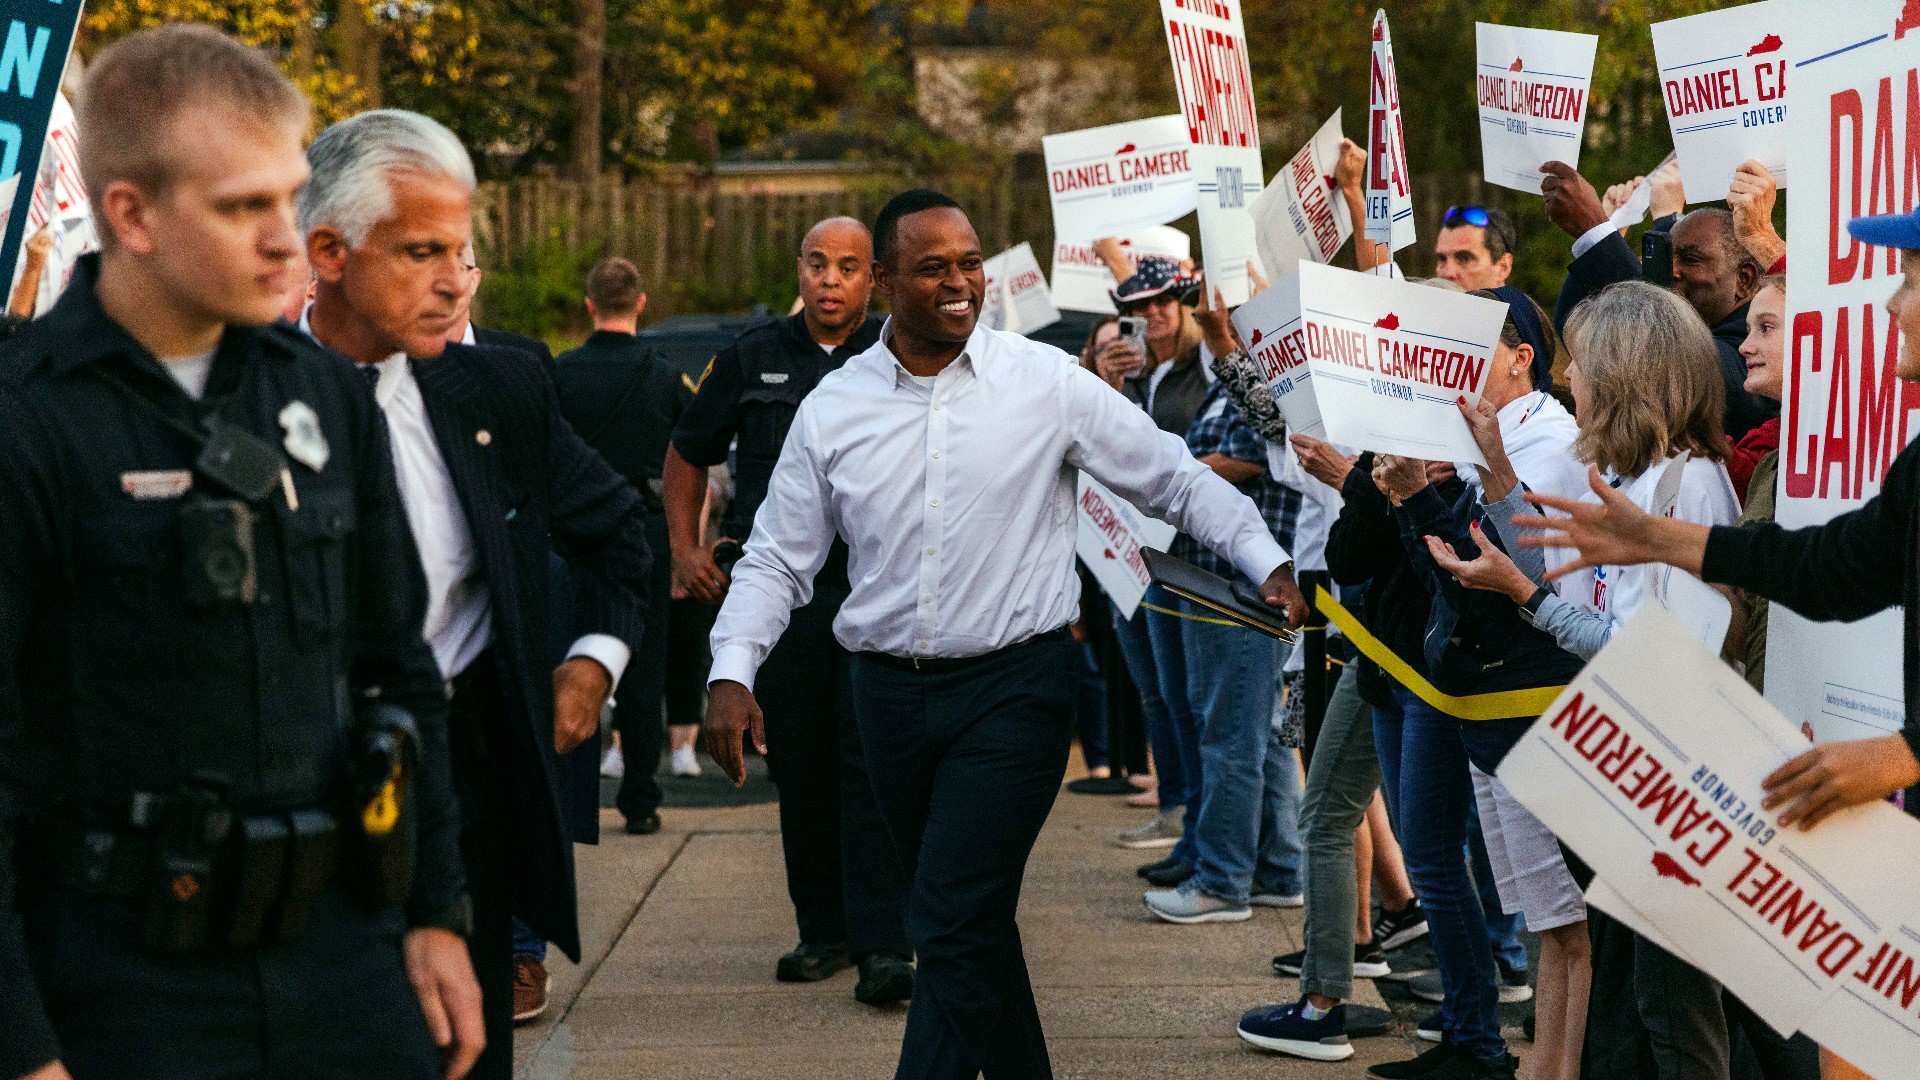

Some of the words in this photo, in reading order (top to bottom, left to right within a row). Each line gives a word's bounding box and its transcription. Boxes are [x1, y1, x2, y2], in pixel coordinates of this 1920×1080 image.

[1479, 75, 1509, 111] DANIEL
[1511, 80, 1583, 122] CAMERON
[1666, 68, 1749, 117] DANIEL
[1742, 105, 1787, 128] GOVER
[1053, 162, 1116, 193] DANIEL
[1302, 185, 1342, 264] CAMERON
[1306, 320, 1375, 372] DANIEL
[1377, 337, 1486, 394] CAMERON
[1370, 377, 1414, 402] GOVERNOR
[1549, 691, 1734, 868] CAMERON
[1689, 764, 1778, 848] GOVERNOR
[1725, 847, 1864, 980] DANIEL
